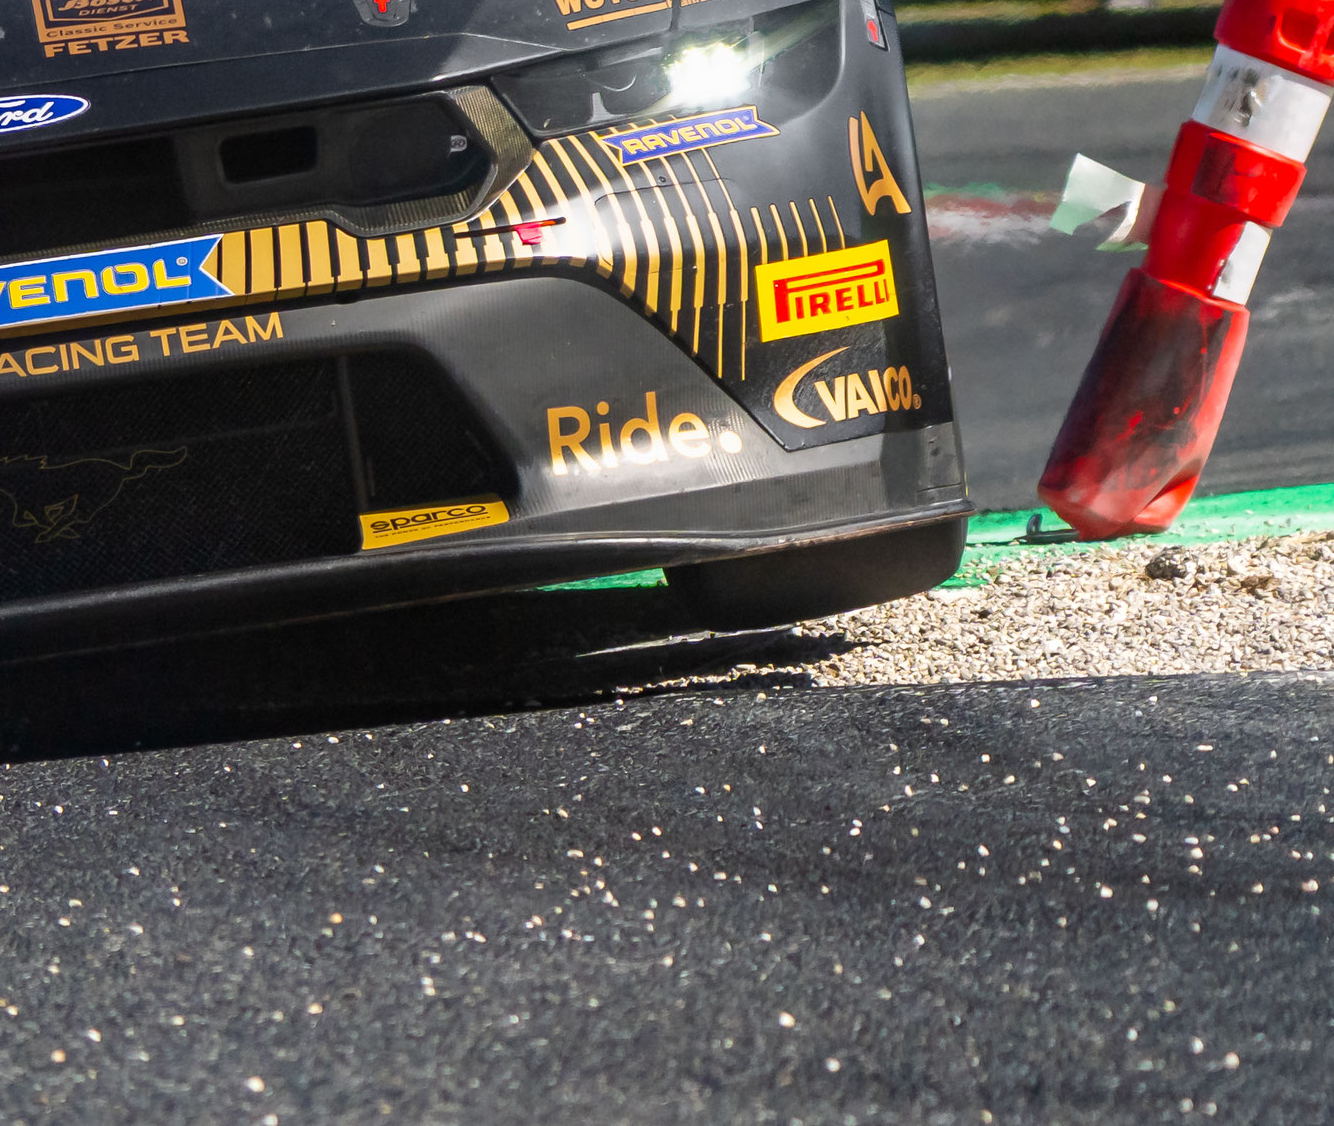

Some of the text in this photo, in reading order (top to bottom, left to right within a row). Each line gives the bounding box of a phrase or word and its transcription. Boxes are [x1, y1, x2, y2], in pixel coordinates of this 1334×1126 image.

[78, 4, 139, 17] DIENST
[43, 29, 191, 58] FETZER
[46, 17, 178, 39] Classic Service
[621, 116, 758, 155] RAVENOL
[773, 258, 891, 324] PIRELLI
[150, 311, 284, 356] TEAM
[547, 391, 743, 476] Ride.
[370, 505, 488, 534] sparco
